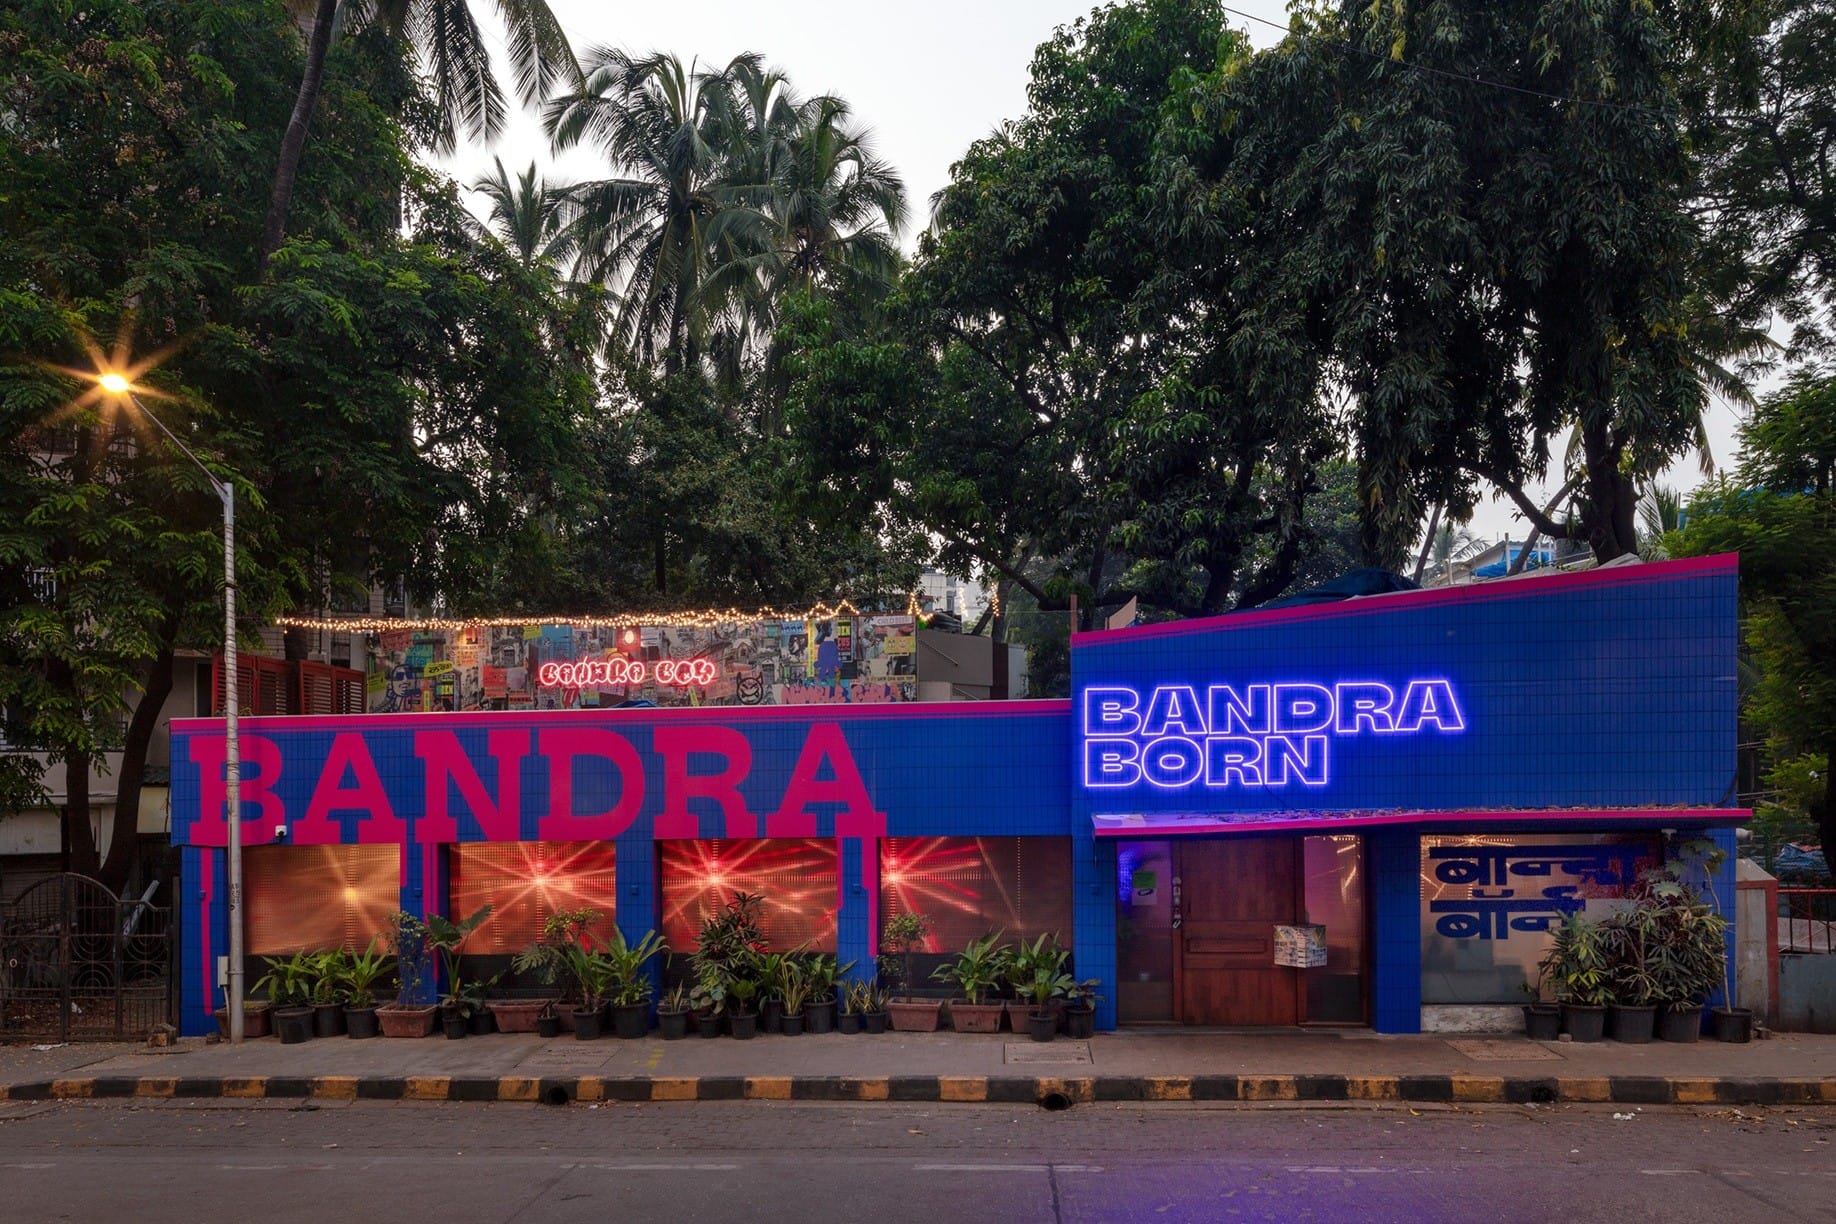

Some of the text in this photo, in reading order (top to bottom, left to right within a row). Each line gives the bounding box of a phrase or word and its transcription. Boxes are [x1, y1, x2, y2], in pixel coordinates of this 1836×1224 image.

[1083, 679, 1465, 736] BANDRA
[188, 723, 888, 845] BANDRA
[1083, 735, 1329, 788] BORN
